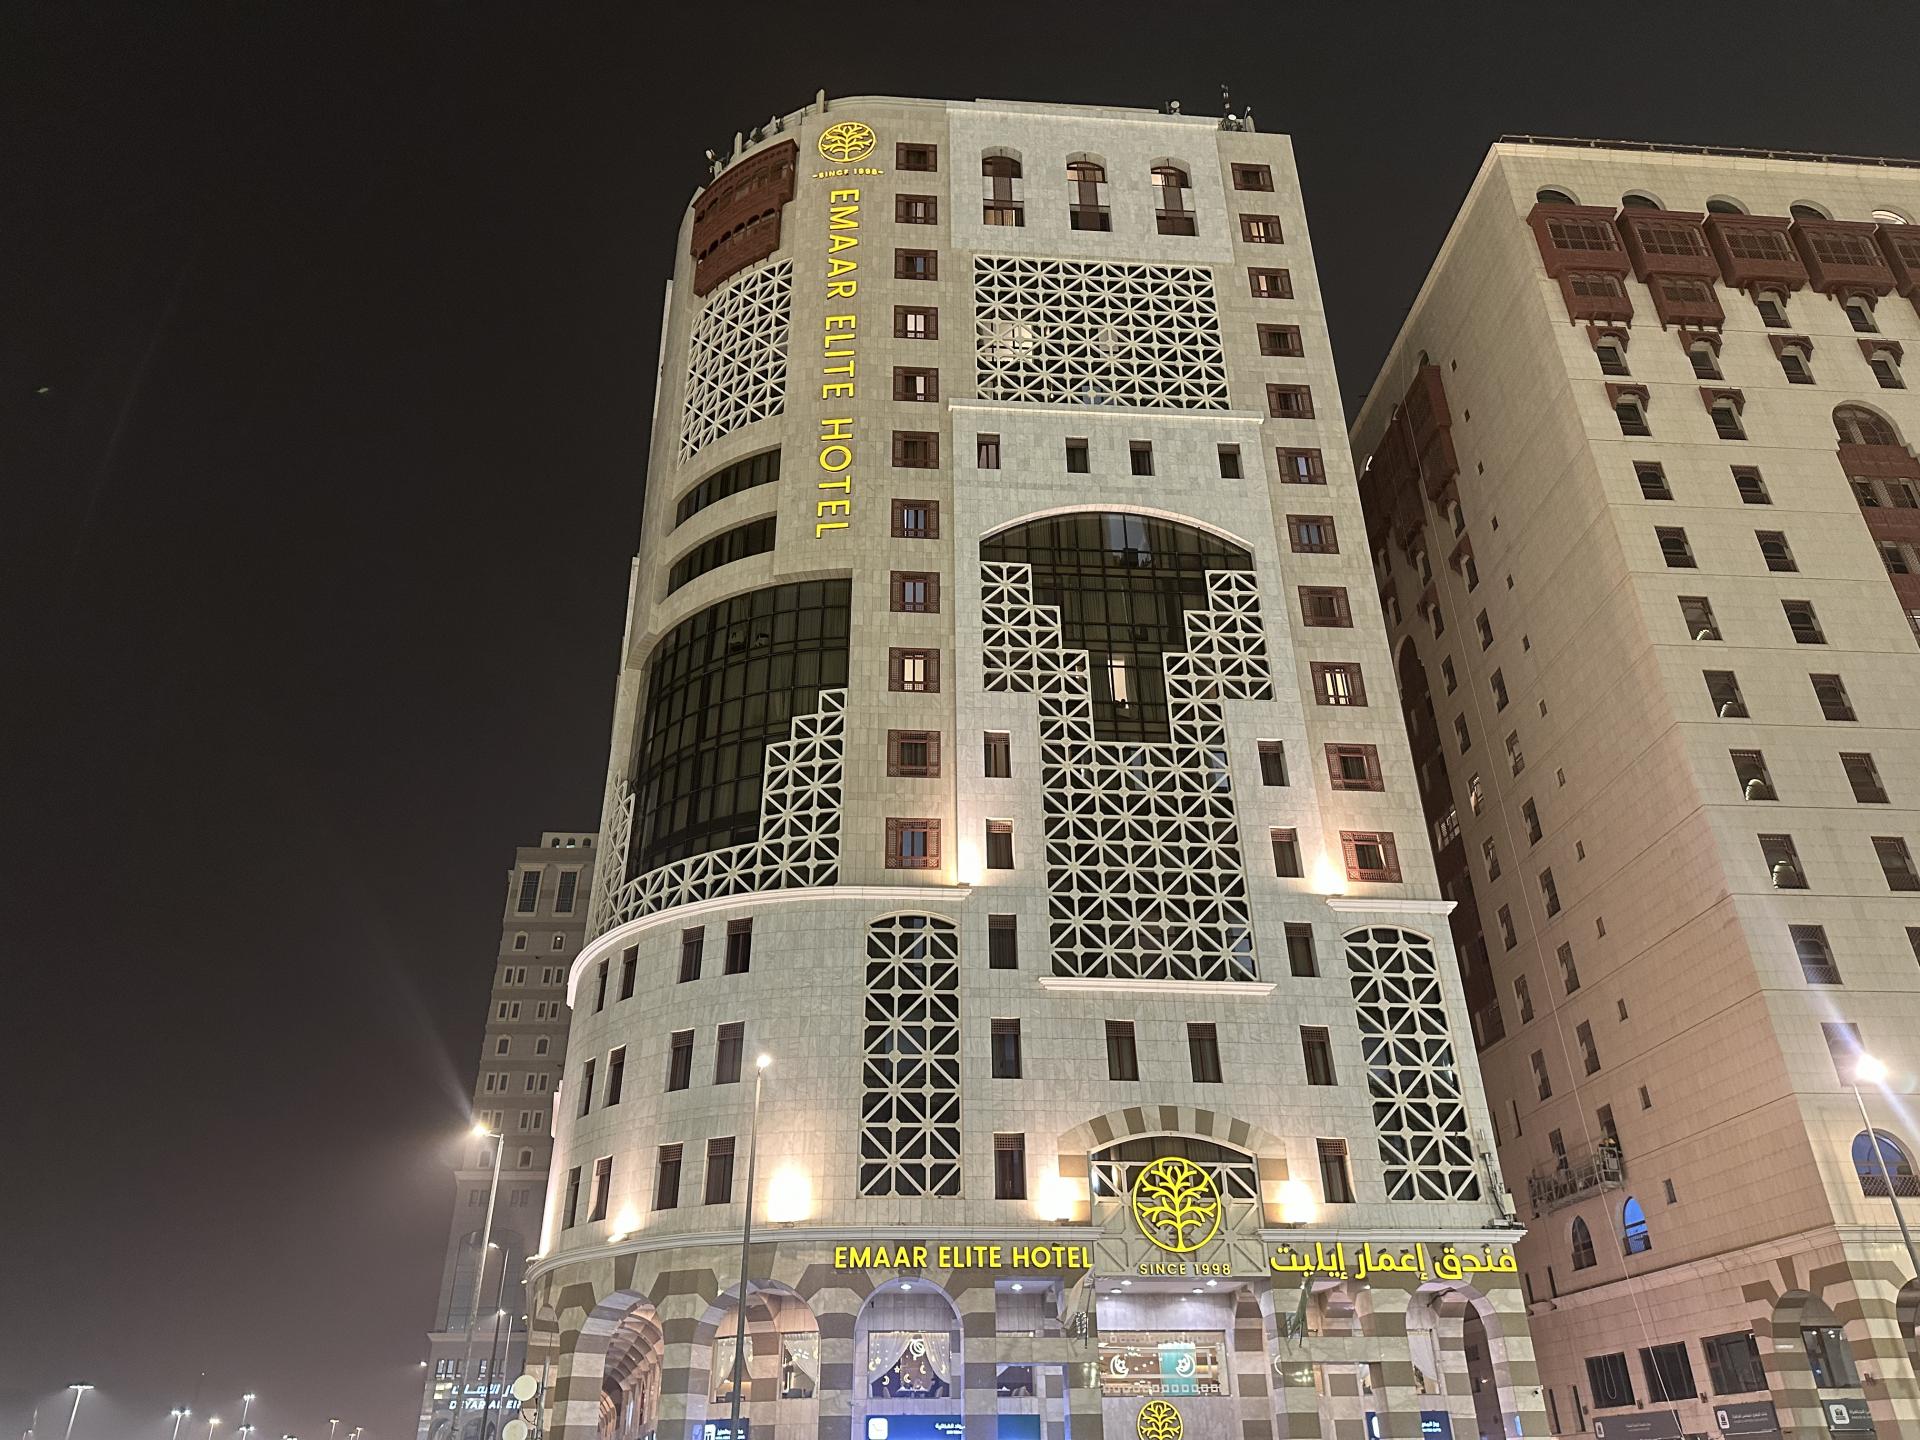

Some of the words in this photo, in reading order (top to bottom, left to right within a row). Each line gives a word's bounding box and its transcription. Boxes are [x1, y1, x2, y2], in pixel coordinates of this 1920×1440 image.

[825, 189, 861, 299] EMAAR
[821, 314, 857, 400] ELITE
[815, 417, 853, 538] HOTEL
[834, 1246, 928, 1268] EMAAR
[939, 1246, 1002, 1268] ELITE
[1012, 1246, 1093, 1269] HOTEL
[1140, 1263, 1187, 1275] SINCE
[1194, 1263, 1231, 1275] 1998
[1269, 1242, 1348, 1280] إيليت
[1355, 1242, 1429, 1281] إعمار
[1434, 1247, 1518, 1280] فندق
